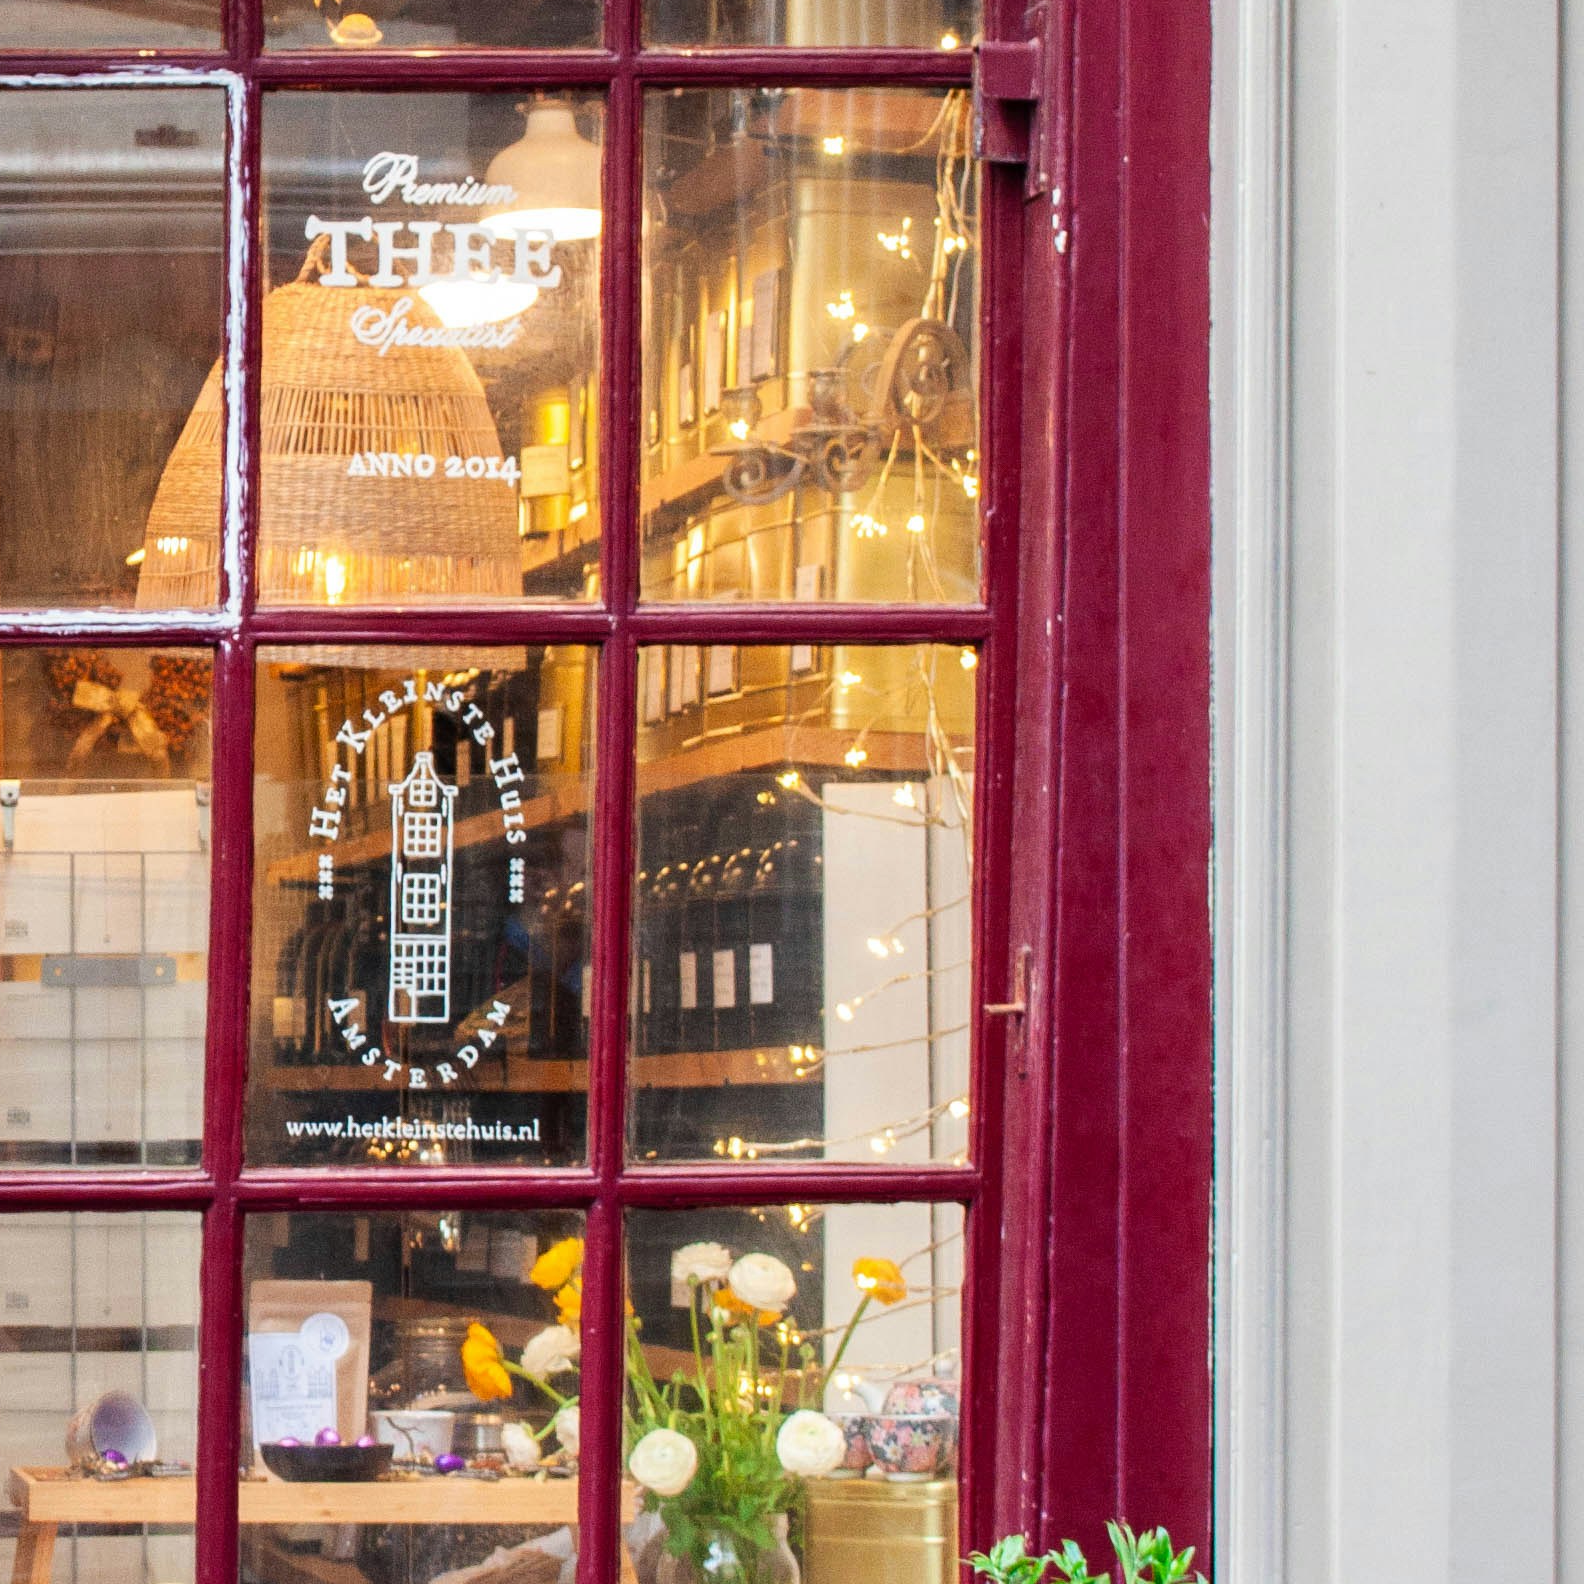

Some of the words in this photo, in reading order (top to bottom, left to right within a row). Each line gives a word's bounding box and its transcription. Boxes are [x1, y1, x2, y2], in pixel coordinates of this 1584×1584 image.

[363, 151, 518, 205] Premium
[304, 215, 562, 288] THEE
[347, 453, 436, 478] ANNO
[444, 454, 522, 487] 2014
[327, 997, 511, 1089] AMSTERDAM
[286, 1115, 541, 1141] www.hetkleinstehuis.nl
